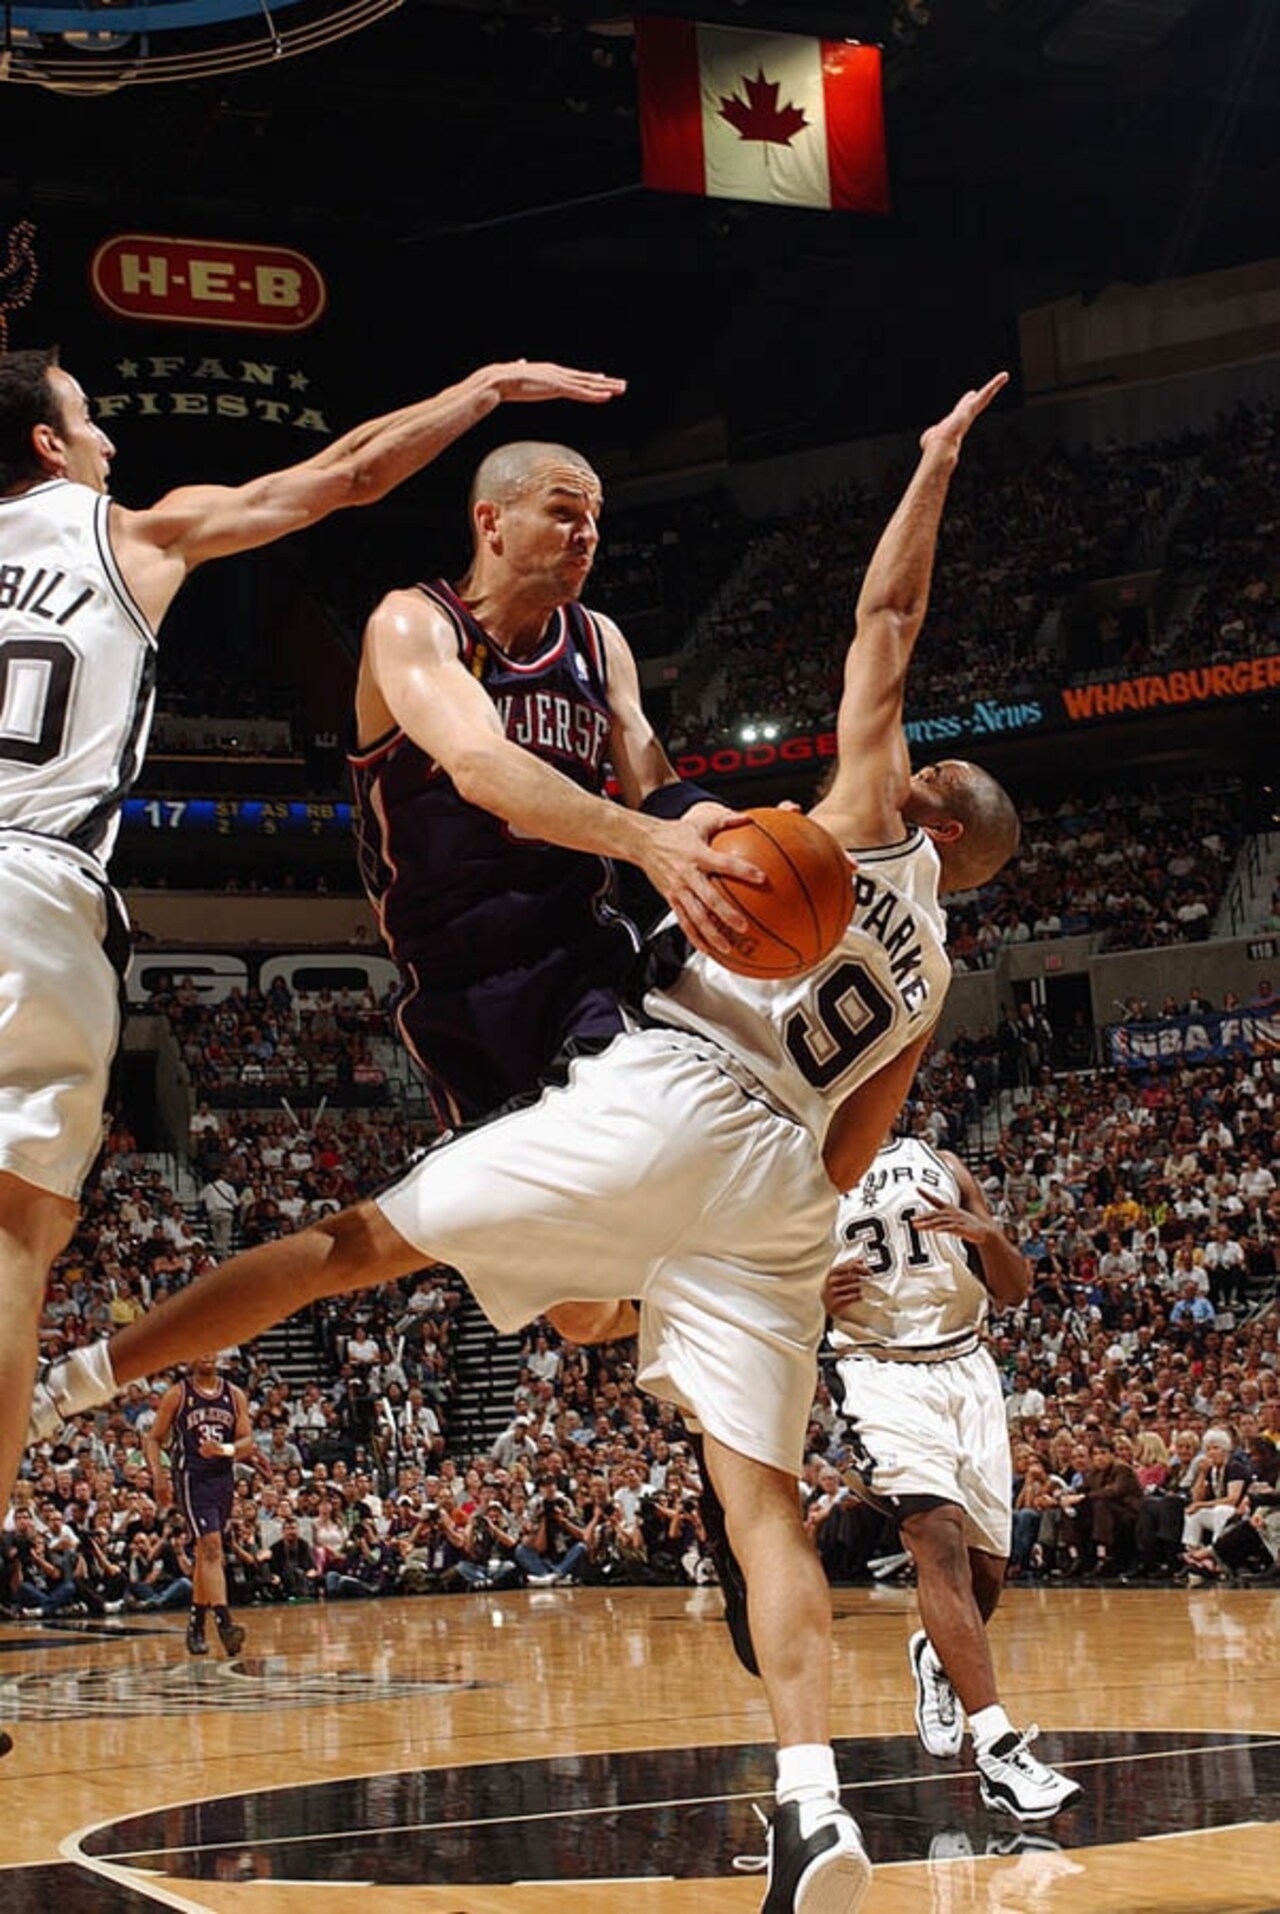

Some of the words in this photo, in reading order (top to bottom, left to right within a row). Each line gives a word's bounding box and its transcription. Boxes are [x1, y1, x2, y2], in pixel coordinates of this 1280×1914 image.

[120, 253, 302, 308] H-E-B
[147, 356, 276, 386] FAN
[94, 392, 331, 433] FIESTA
[144, 801, 187, 828] 17
[856, 875, 928, 1023] PARKE
[785, 962, 896, 1090] 9
[845, 1207, 930, 1274] 31
